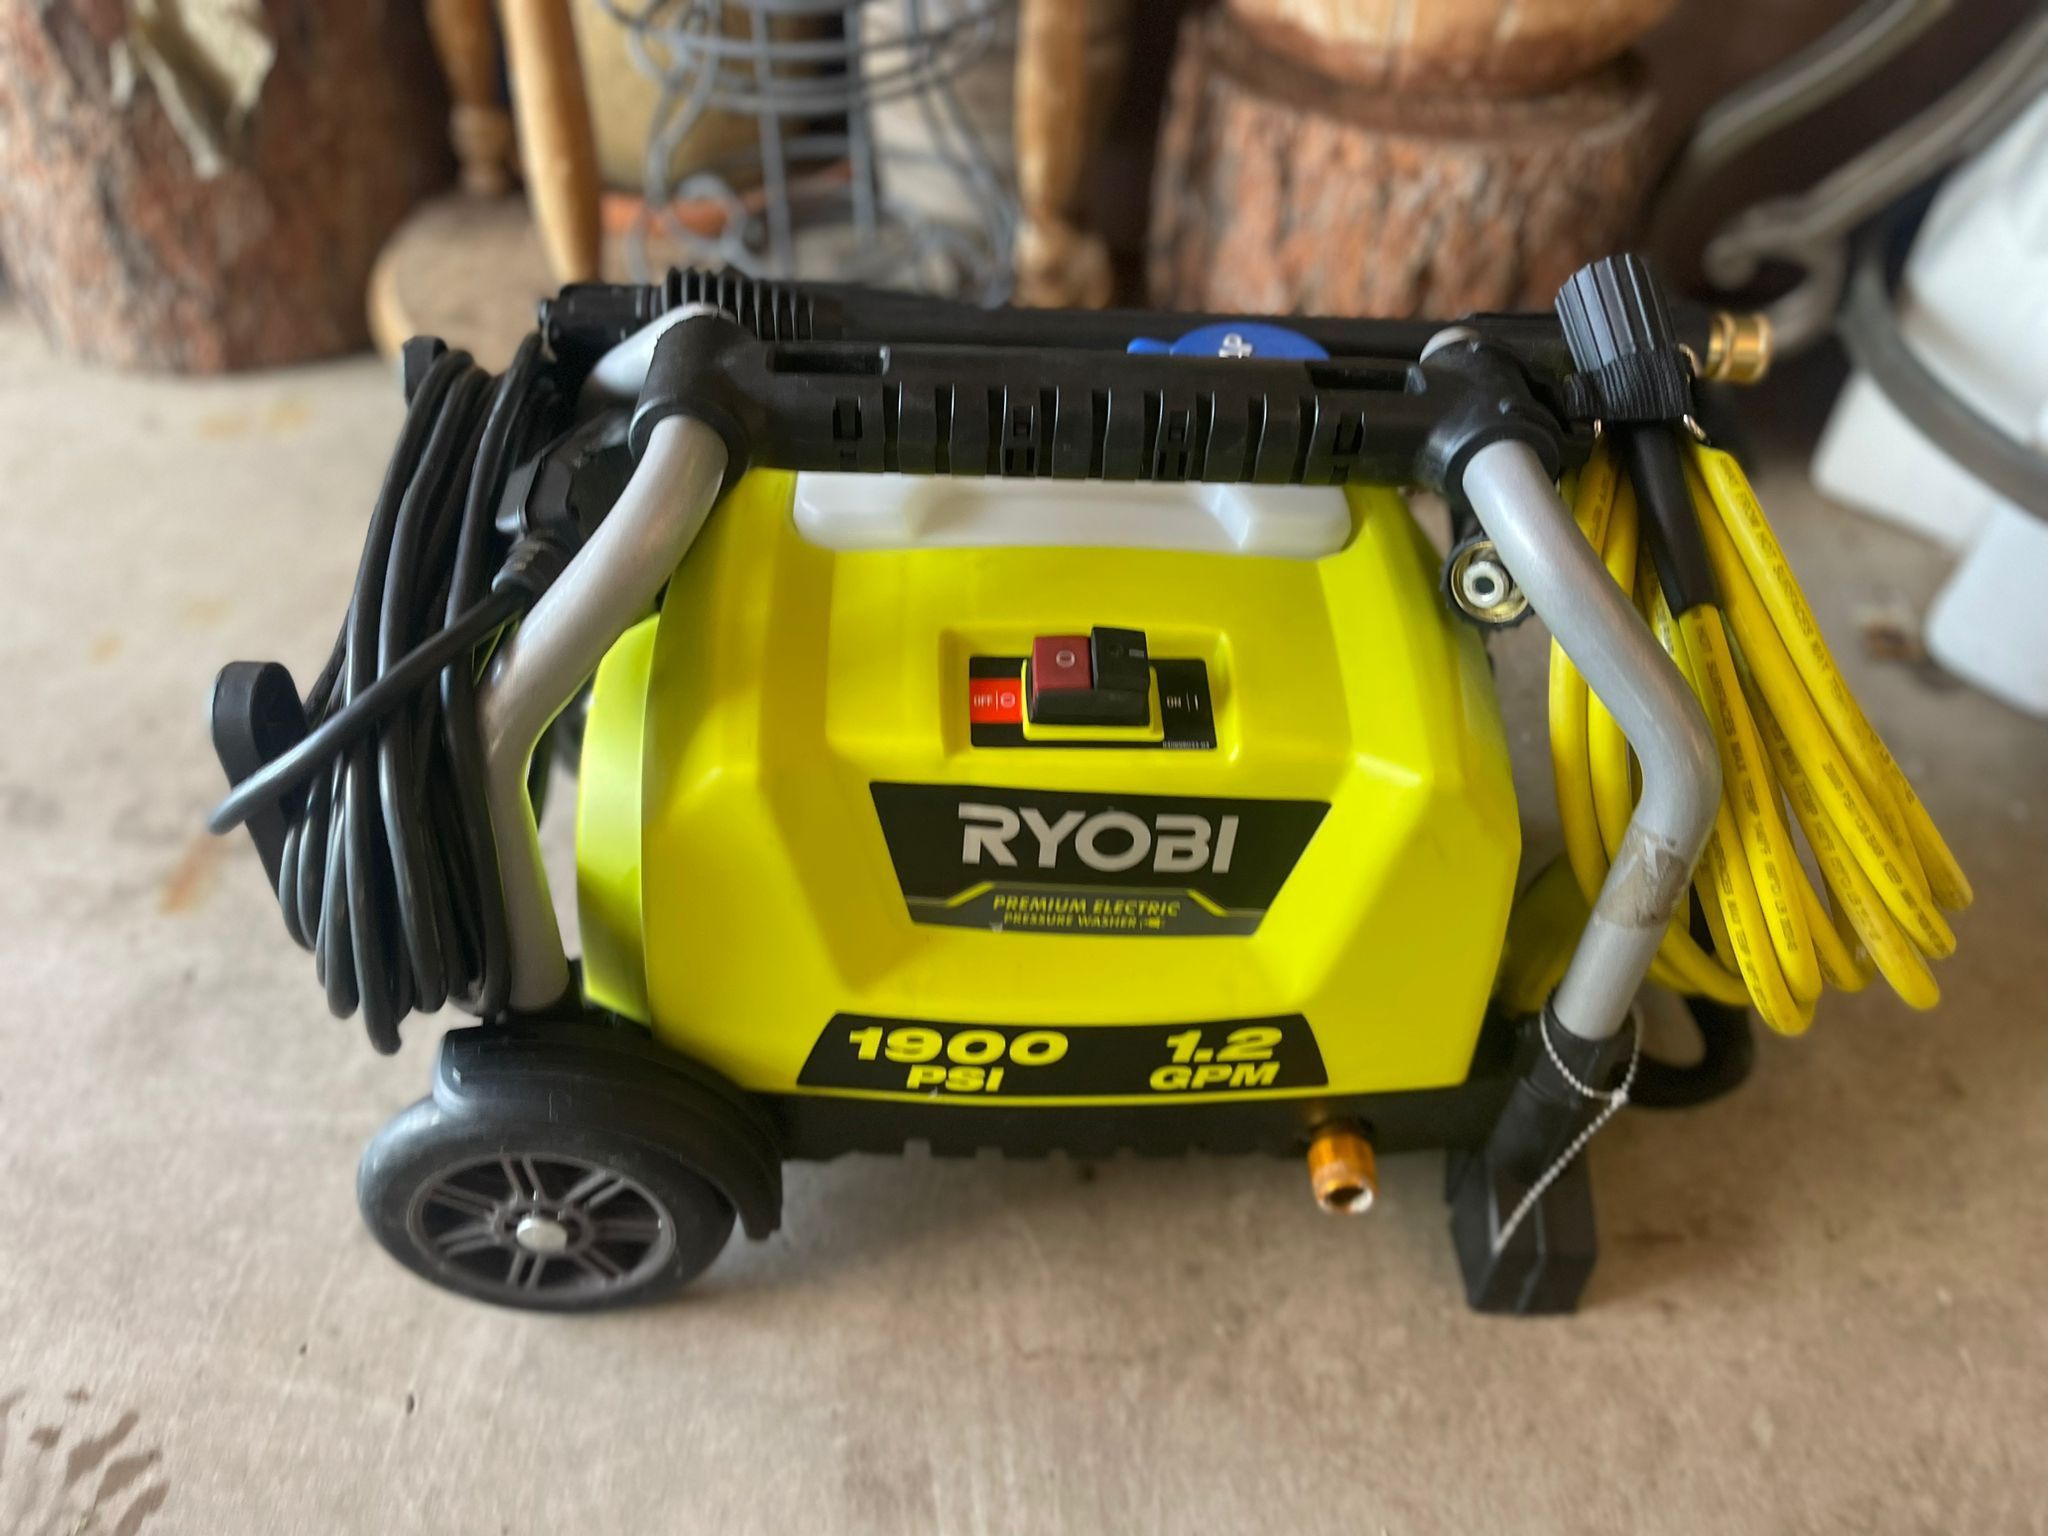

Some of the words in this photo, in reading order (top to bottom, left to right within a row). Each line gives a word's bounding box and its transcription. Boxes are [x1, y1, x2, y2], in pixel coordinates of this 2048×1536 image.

[973, 694, 993, 707] OFF
[1166, 695, 1182, 708] ON
[958, 802, 1239, 874] RYOBI
[993, 894, 1087, 914] PREMIUM
[1093, 899, 1181, 917] ELECTRIC
[1003, 910, 1073, 927] PRESSURE
[1078, 914, 1137, 930] WASHER
[849, 1026, 1069, 1066] 1900
[1166, 1026, 1283, 1064] 1.2
[906, 1063, 1005, 1092] PSI
[1149, 1062, 1280, 1091] GPM
